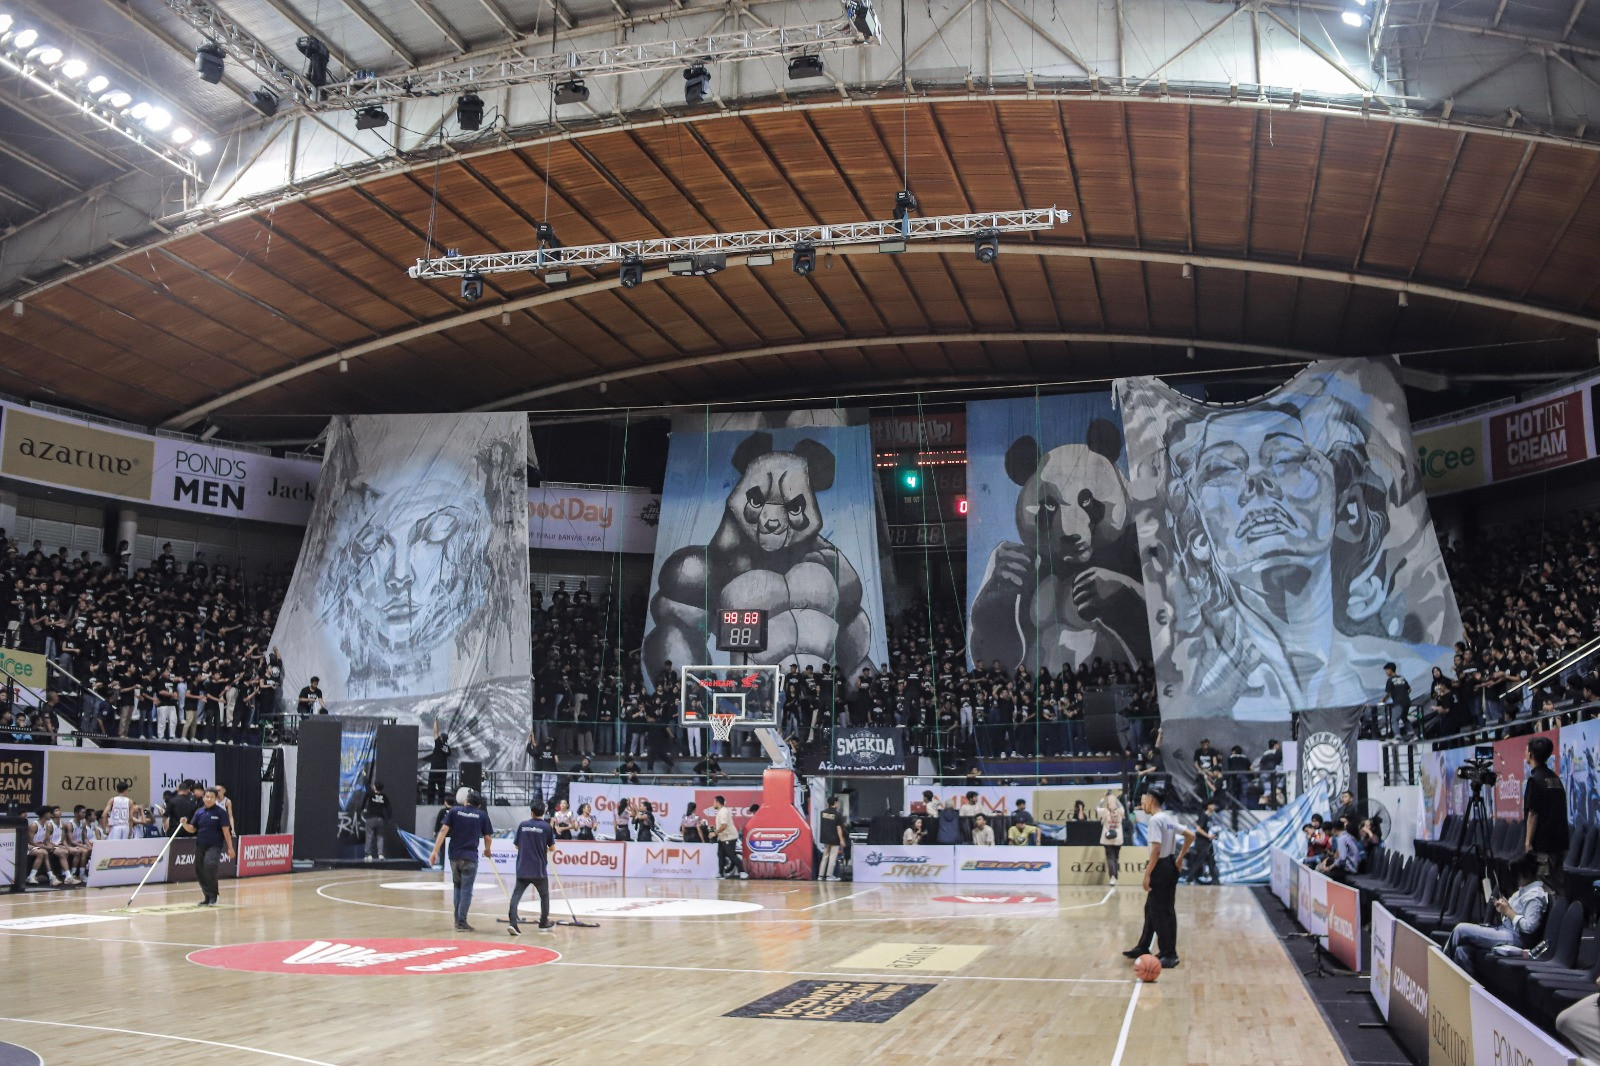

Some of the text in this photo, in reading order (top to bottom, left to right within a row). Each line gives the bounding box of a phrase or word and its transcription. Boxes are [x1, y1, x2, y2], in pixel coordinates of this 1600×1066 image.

[1508, 429, 1567, 466] CREAM
[176, 450, 247, 478] POND'S
[907, 476, 916, 487] 4
[173, 476, 245, 510] MEN
[837, 738, 895, 756] SMEKDA
[161, 773, 208, 788] Jacon
[267, 844, 289, 858] CREAM
[646, 849, 700, 864] MPM
[882, 864, 949, 877] STREET
